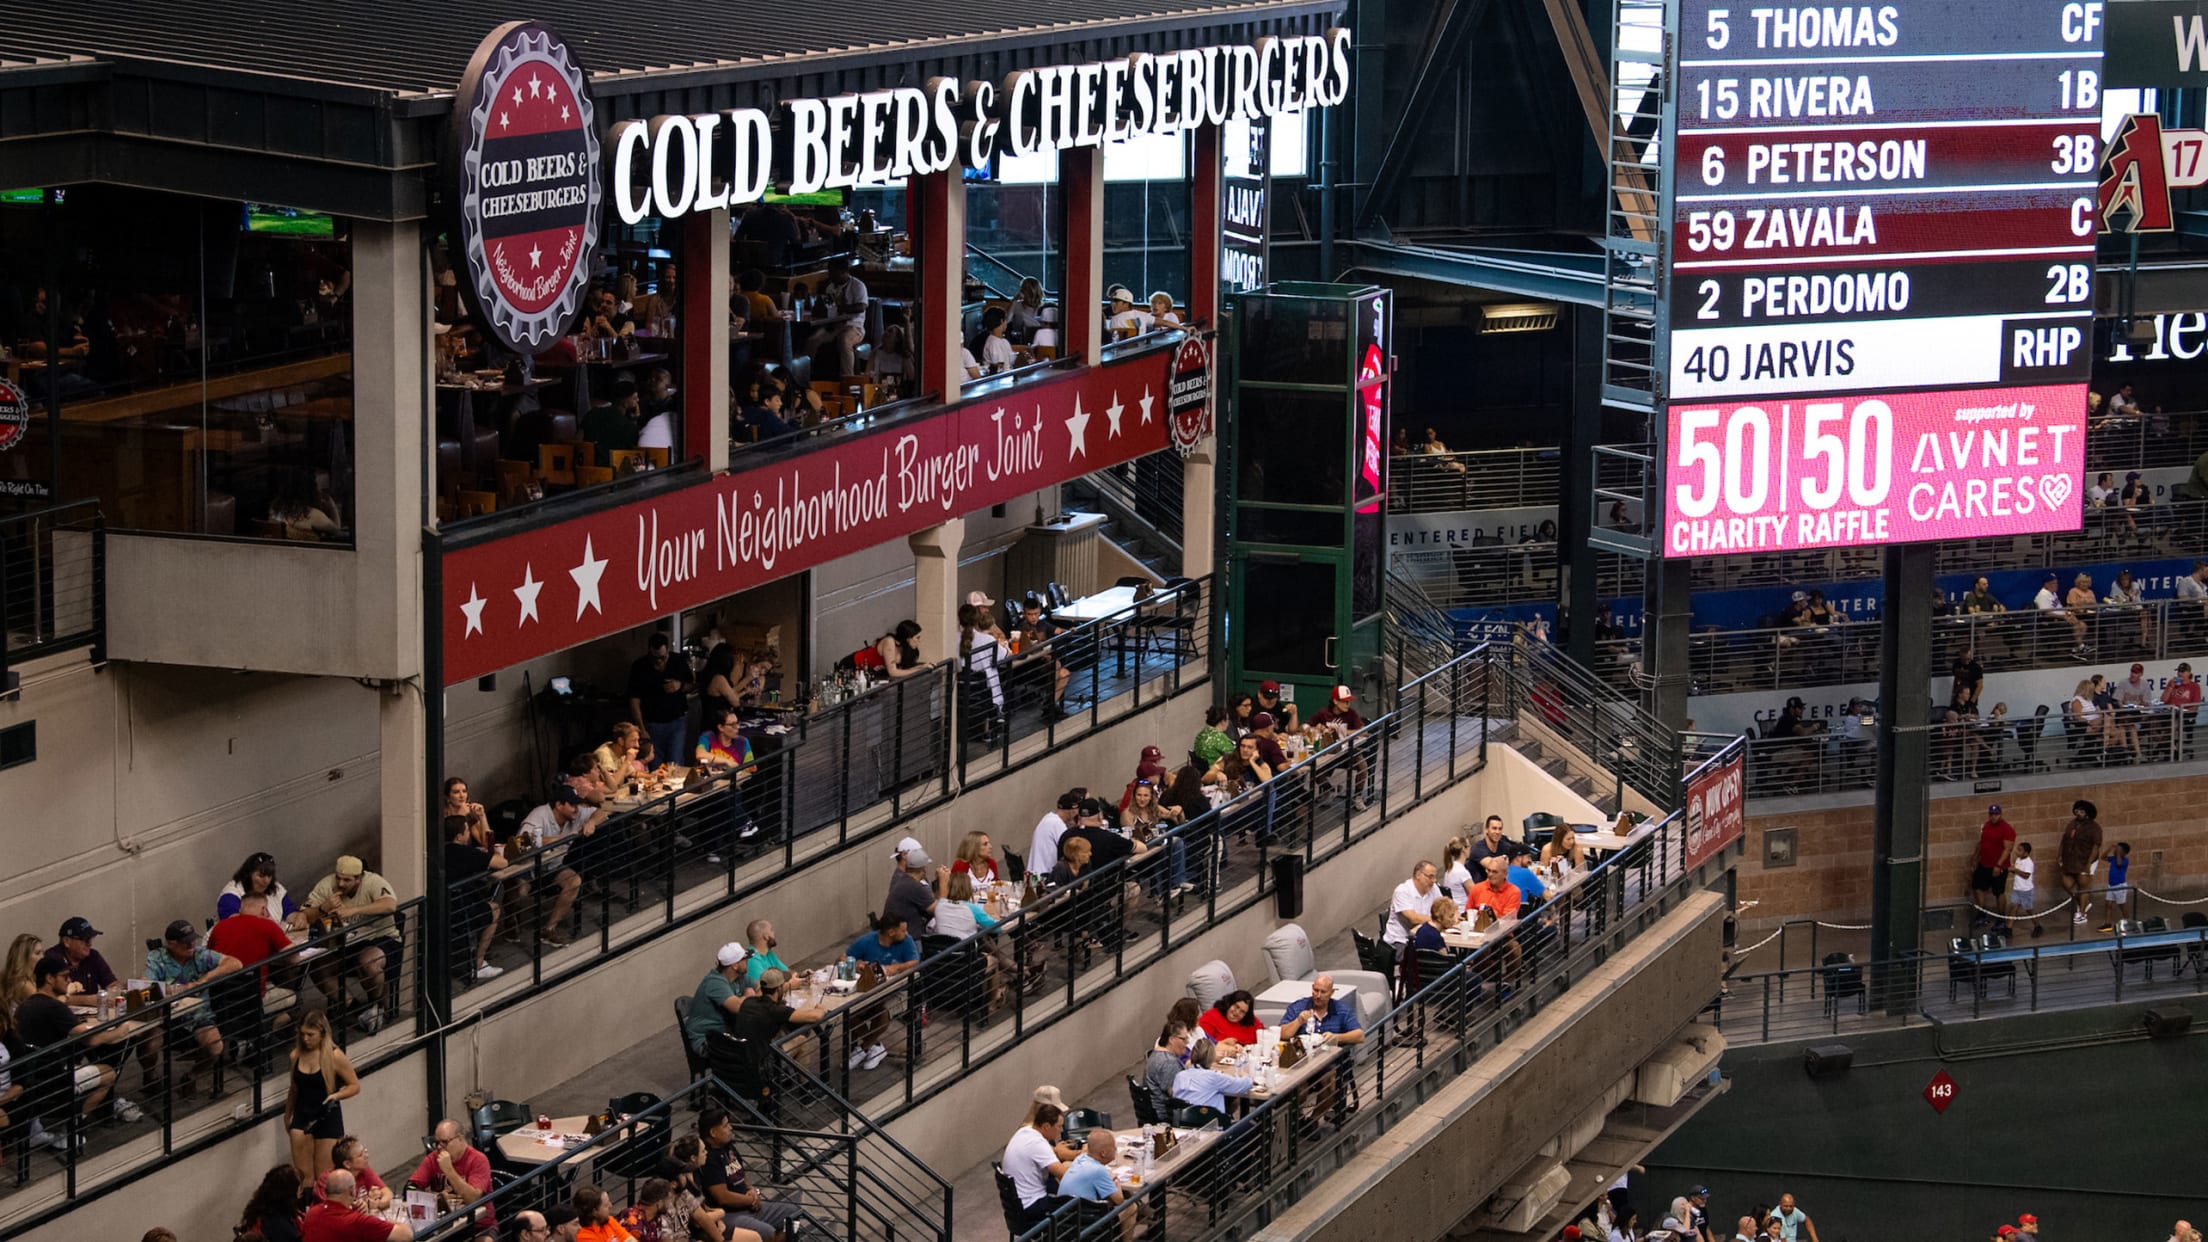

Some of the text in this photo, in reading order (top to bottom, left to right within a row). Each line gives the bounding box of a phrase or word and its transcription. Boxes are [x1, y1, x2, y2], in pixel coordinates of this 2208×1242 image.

[1706, 3, 2100, 50] 5 THOMAS CF
[1697, 69, 2098, 120] 15 RIVERA 1B
[614, 28, 1351, 225] COLD BEERS & CHEESEBURGERS
[481, 152, 588, 188] COLD BEERS &
[1701, 133, 2096, 187] 6 PETERSON 3B
[2171, 139, 2203, 178] 17
[481, 184, 587, 219] CHEESEBURGERS
[1688, 197, 2093, 252] 59 ZAVALA C
[493, 229, 578, 302] Neighborhood Burger Joint
[1696, 264, 2090, 320] 2 PERDOMO 2B
[1684, 325, 2081, 383] 40 JARVIS RHP
[1954, 402, 2035, 424] supported by
[1911, 424, 2071, 474] AVNET
[637, 403, 1044, 611] Your Neighborhood Burger Joint
[1907, 477, 2035, 522] CARES
[1390, 527, 1484, 547] ENTERED
[1673, 509, 1890, 552] CHARITY RAFFLE
[1931, 1083, 1952, 1099] 143
